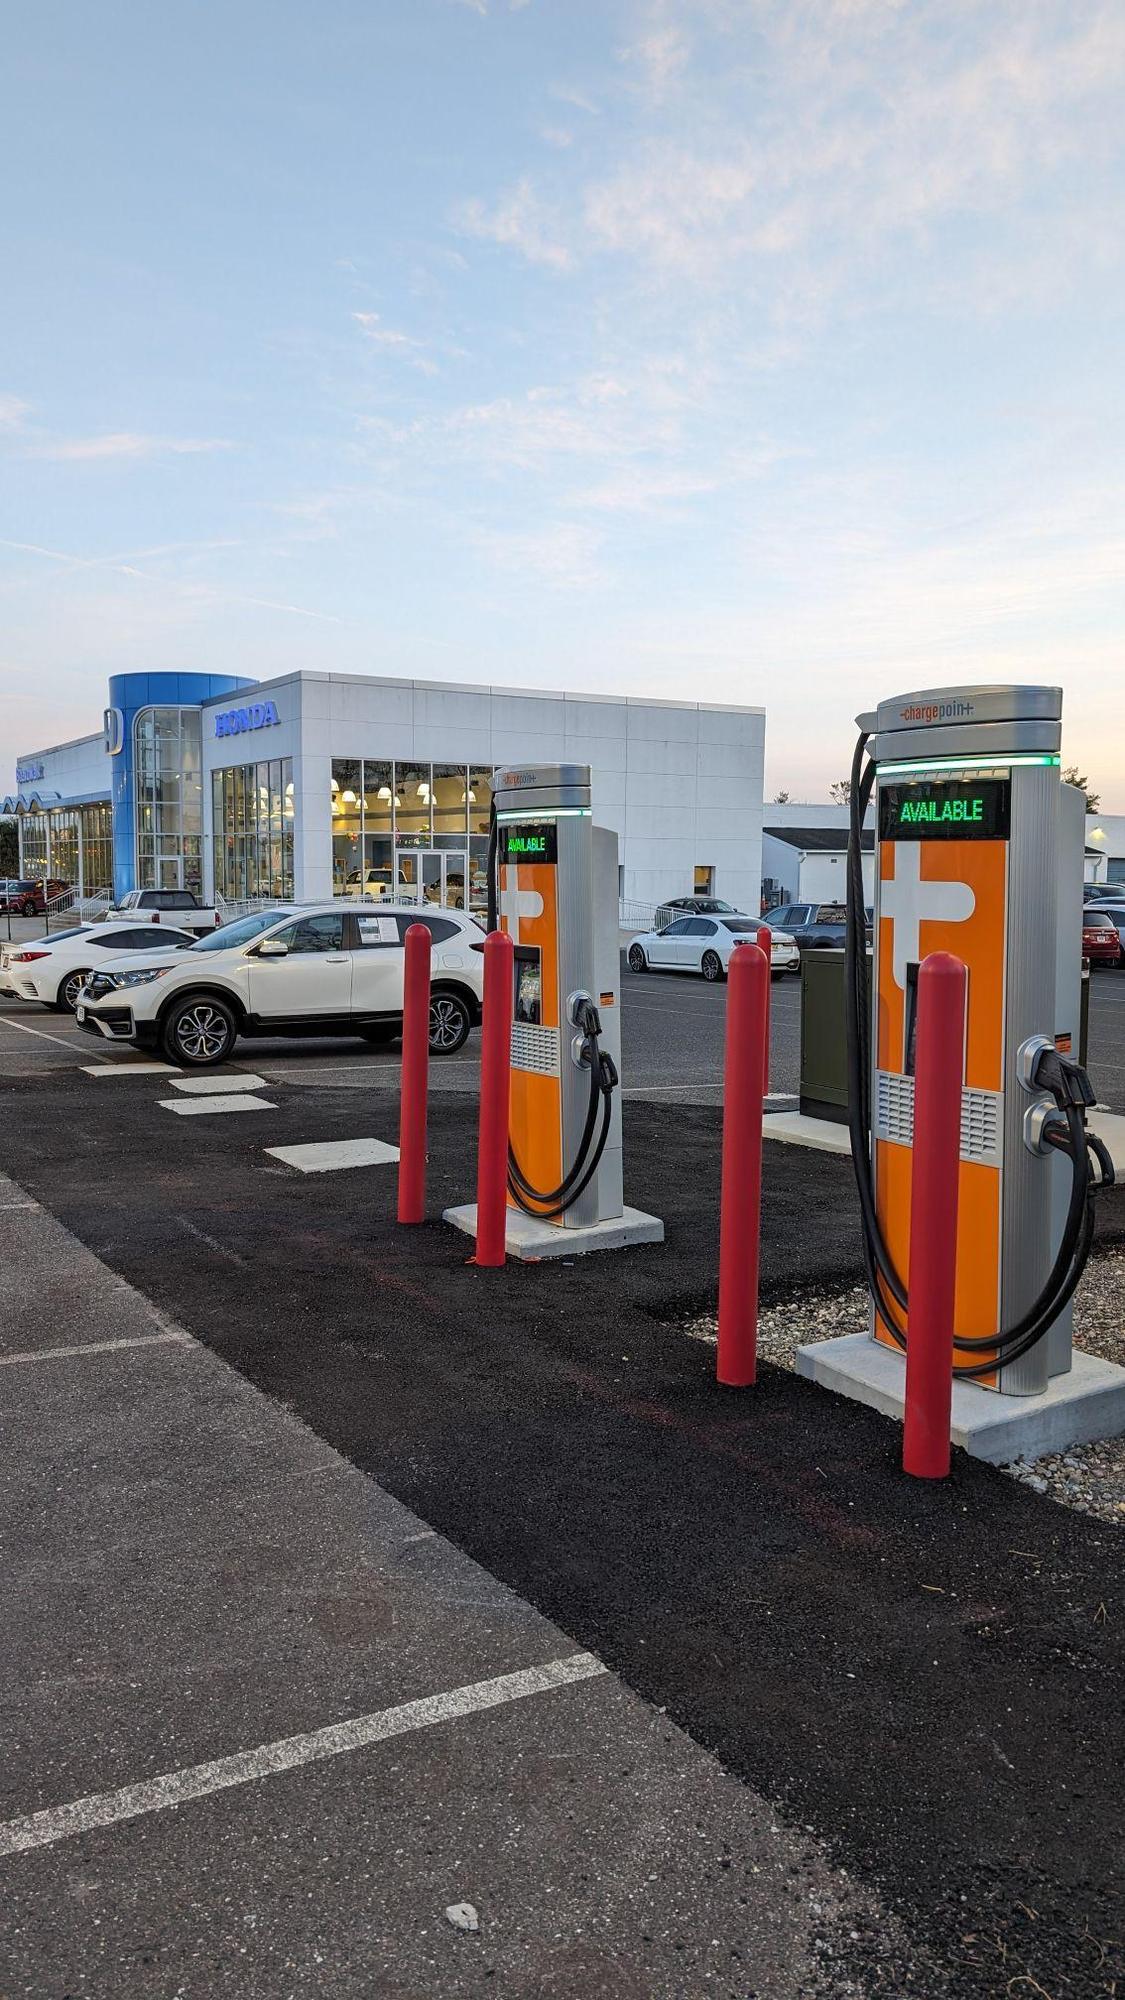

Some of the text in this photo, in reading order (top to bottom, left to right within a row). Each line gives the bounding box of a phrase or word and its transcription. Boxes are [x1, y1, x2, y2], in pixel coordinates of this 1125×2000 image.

[215, 701, 280, 737] HONDA
[900, 799, 983, 822] AVAILABLE
[507, 837, 546, 852] AVAILABLE
